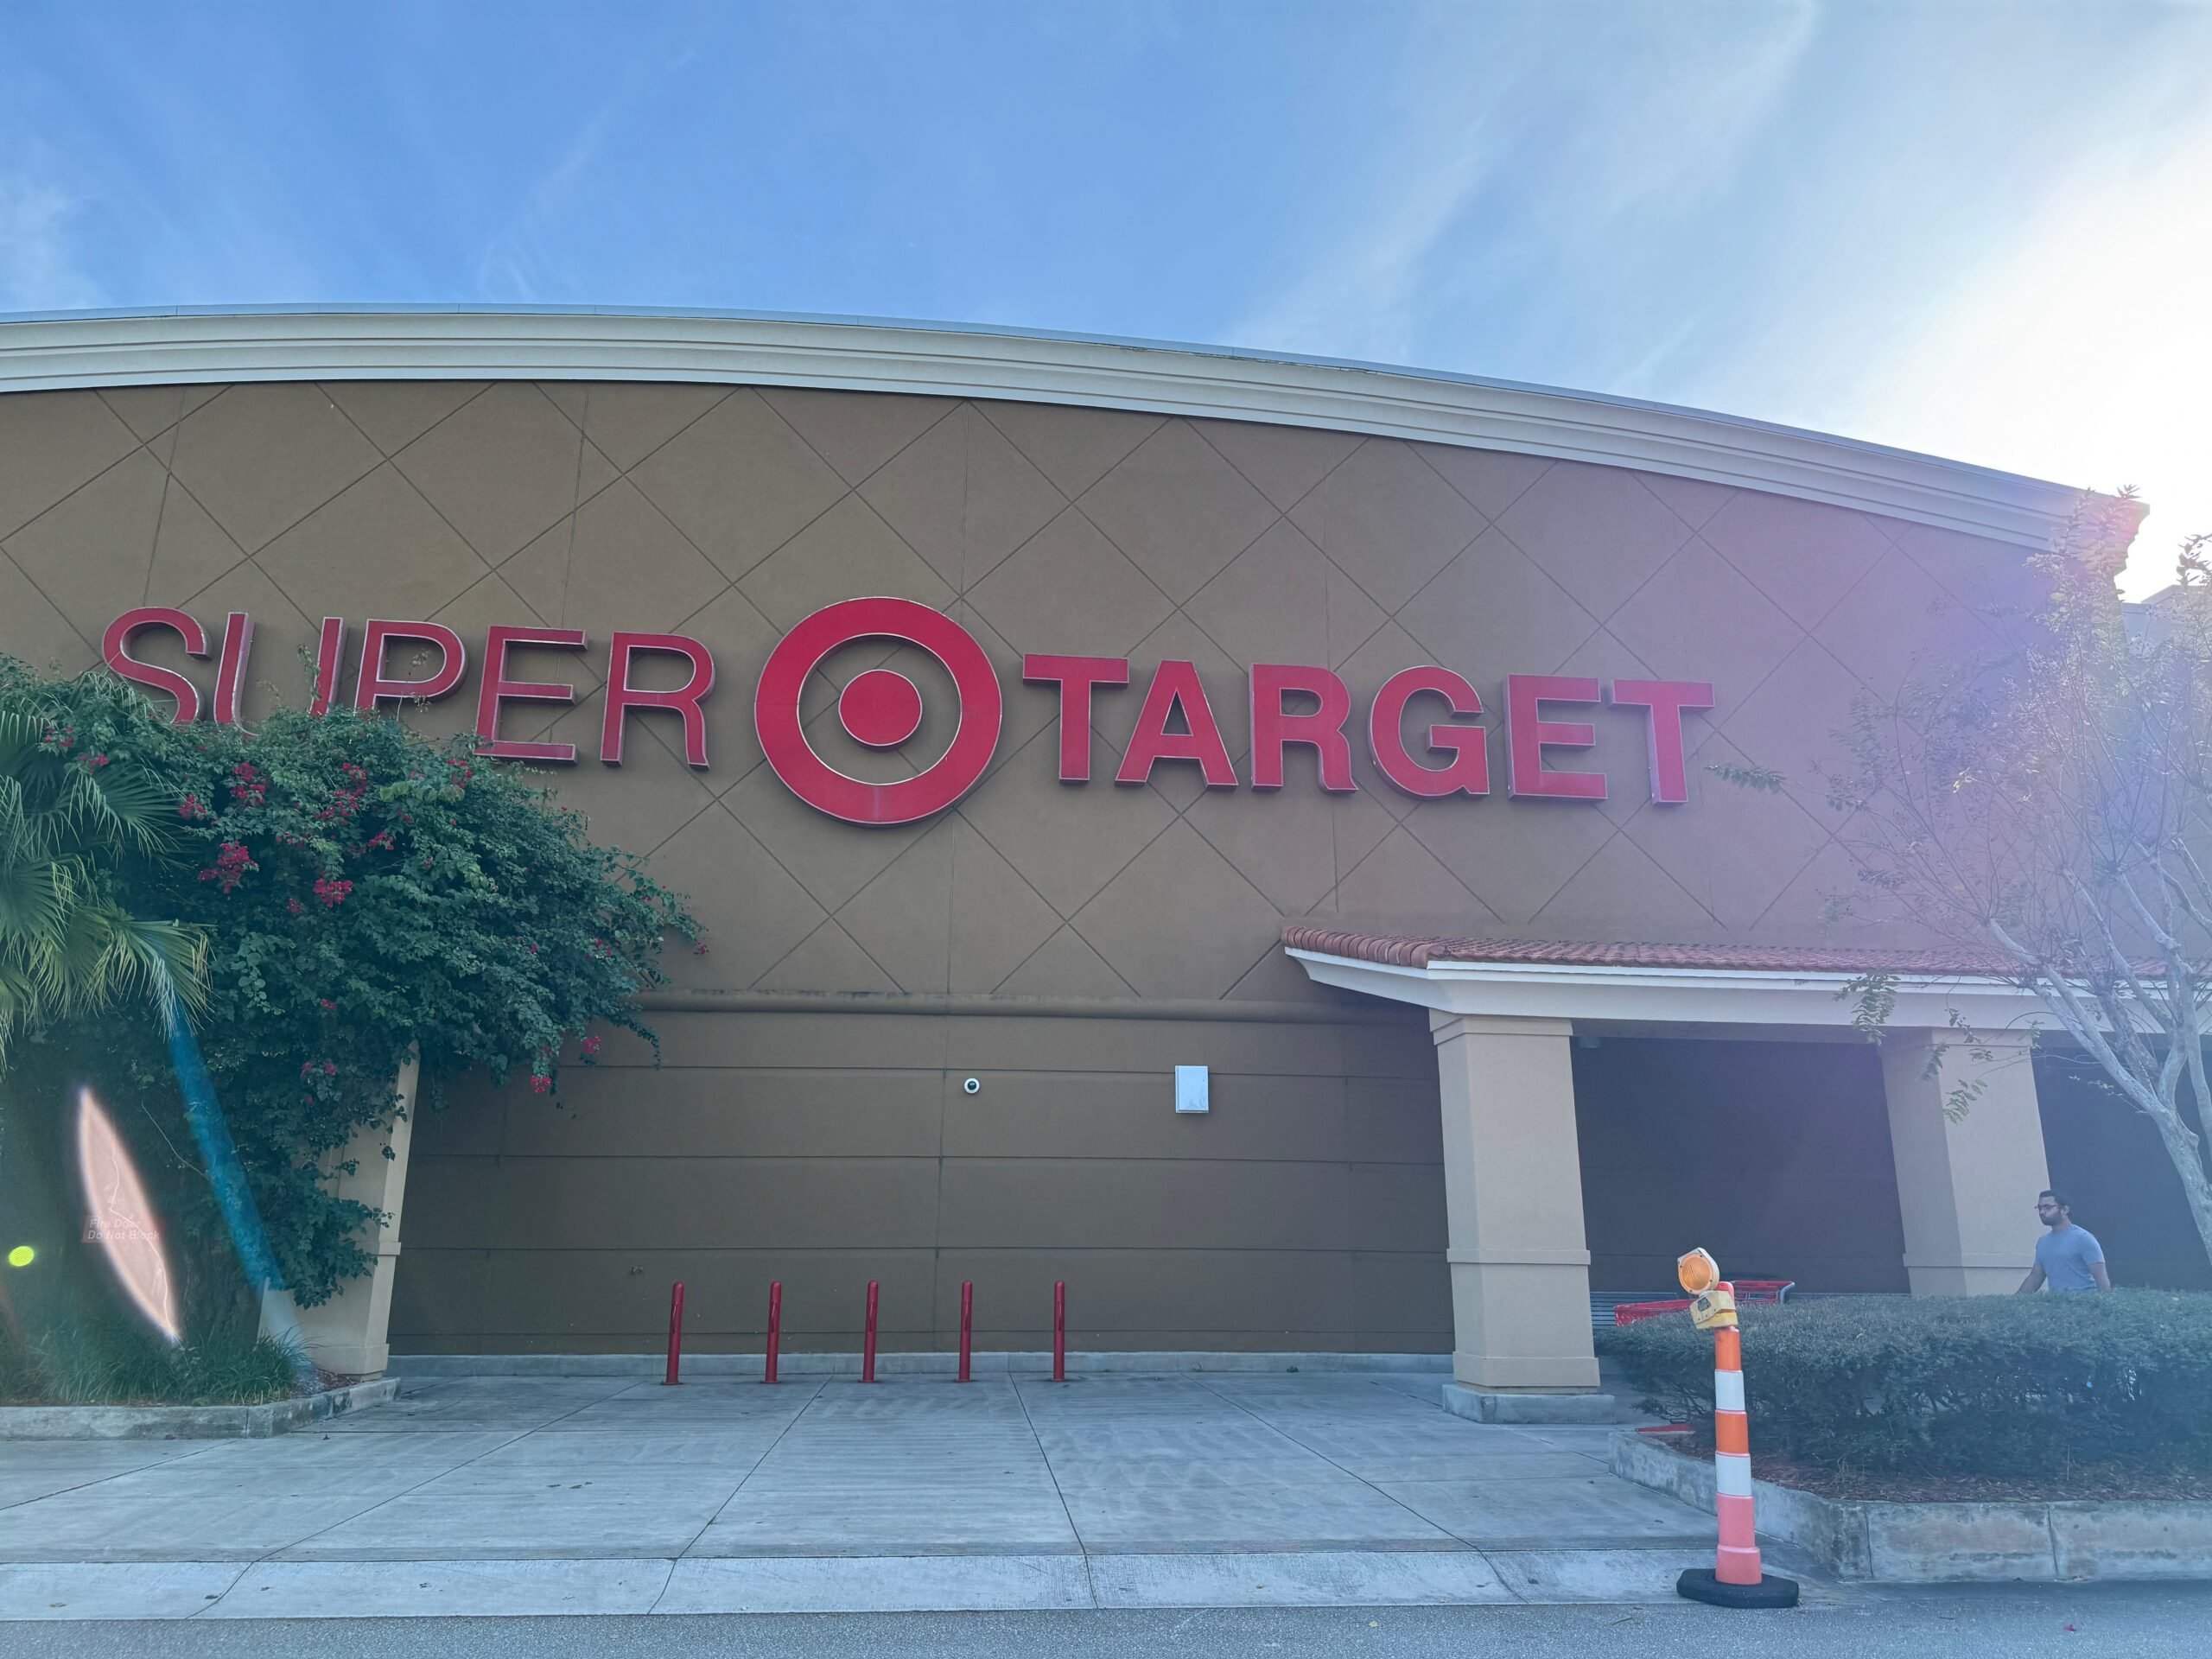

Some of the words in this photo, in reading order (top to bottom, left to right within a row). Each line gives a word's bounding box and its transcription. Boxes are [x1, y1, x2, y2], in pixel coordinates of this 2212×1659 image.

[101, 607, 716, 769] SUPER
[1023, 654, 1714, 804] TARGET
[90, 1218, 111, 1228] Fire
[87, 1230, 103, 1240] Do
[106, 1230, 126, 1240] Not
